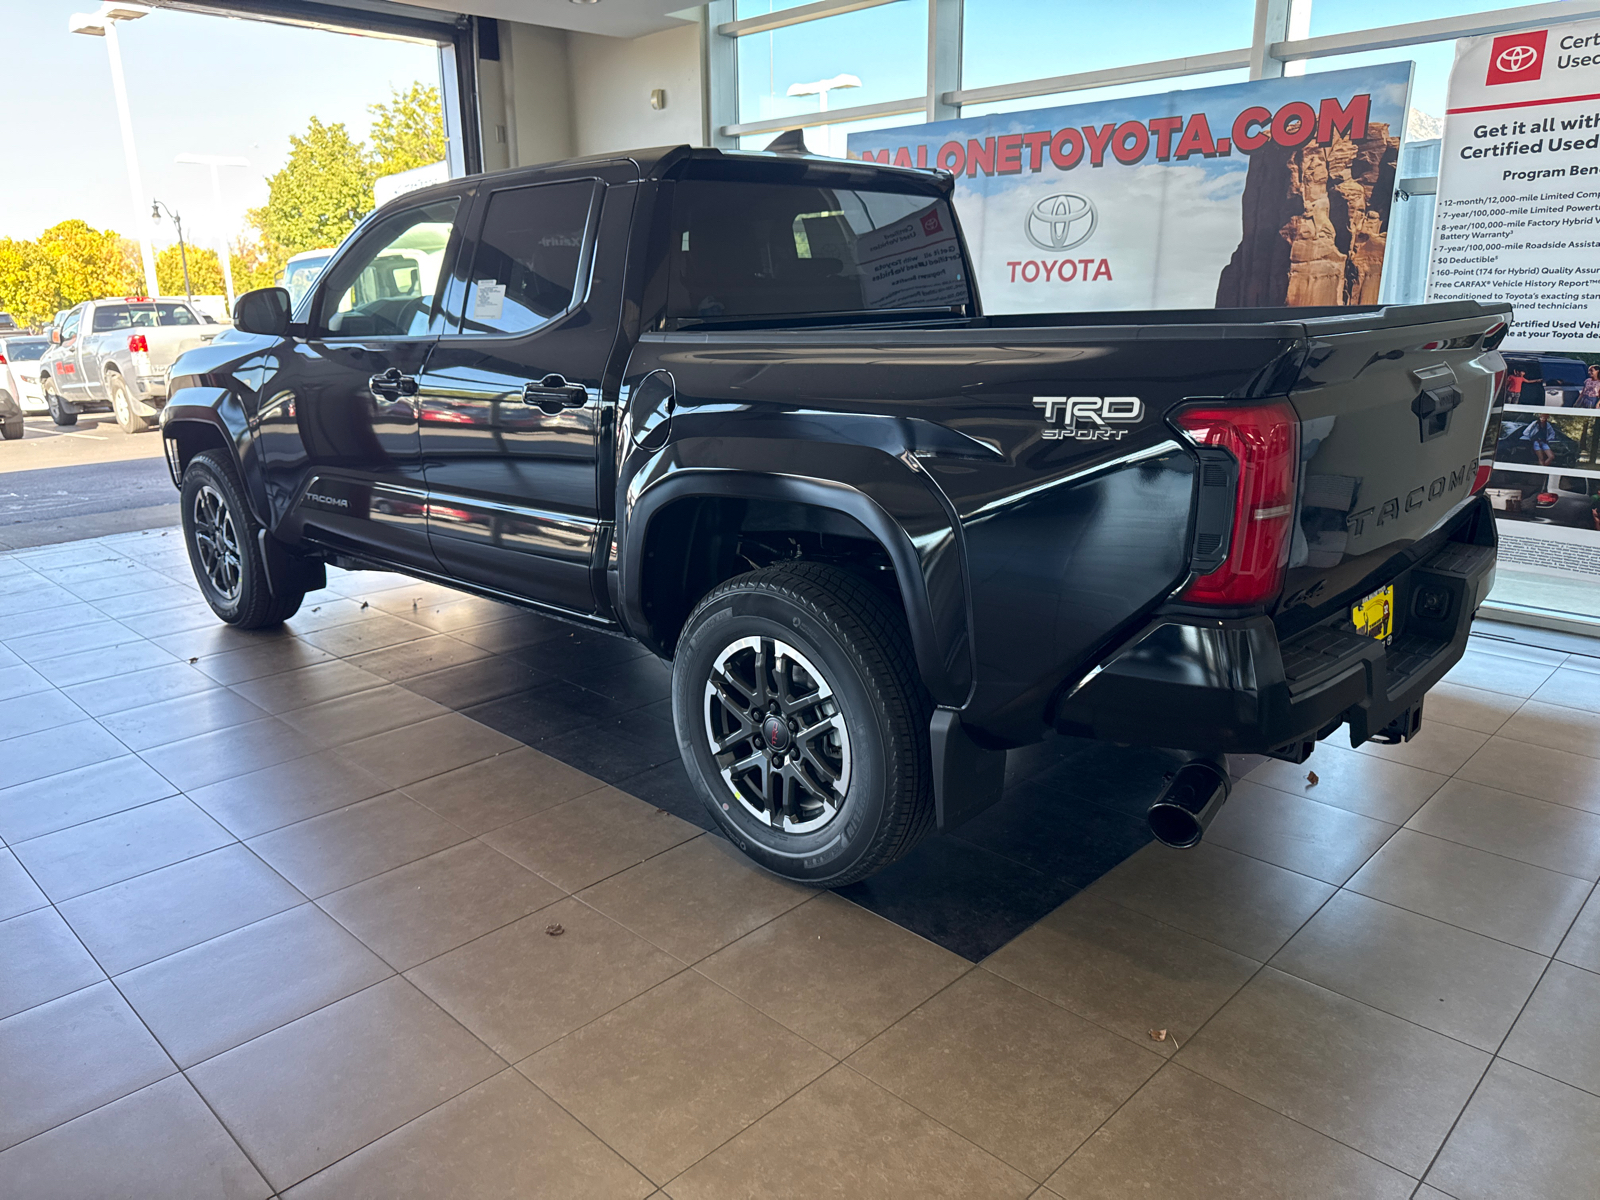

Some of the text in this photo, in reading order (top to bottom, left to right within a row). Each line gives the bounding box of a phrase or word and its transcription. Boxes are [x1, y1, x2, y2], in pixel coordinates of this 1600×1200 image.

[1473, 113, 1600, 139] Get it all with
[862, 94, 1371, 179] MALONETOYOTA.COM
[1460, 134, 1600, 160] Certified Used
[1502, 164, 1600, 182] Program Ben
[1444, 193, 1539, 207] 12-month/12,000-mile
[1540, 191, 1575, 201] Limited
[1443, 203, 1600, 220] 7-year/100,000-mile Limited Powert
[1441, 220, 1526, 232] 8-year/100,000-mile
[1527, 219, 1561, 228] Factory
[1562, 216, 1594, 227] Hybrid
[1440, 233, 1470, 241] Battery
[1439, 241, 1524, 254] 7-year/100,000-mile
[1525, 241, 1567, 250] Roadside
[1437, 257, 1448, 265] $0
[1007, 259, 1113, 283] TOYOTA
[1436, 268, 1475, 276] 160-Point
[1475, 268, 1493, 276] (174
[1494, 267, 1506, 275] for
[1507, 267, 1540, 276] Hybrid)
[1541, 266, 1574, 276] Quality
[1492, 279, 1523, 288] Vehicle
[1524, 279, 1557, 289] History
[1433, 292, 1493, 300] Reconditioned
[1504, 292, 1539, 301] Toyota's
[1540, 292, 1579, 302] exacting
[1512, 302, 1588, 310] ained technicians
[1510, 320, 1551, 328] Certified
[1552, 320, 1577, 329] Used
[1516, 330, 1527, 338] at
[1527, 331, 1551, 340] your
[1551, 330, 1584, 340] Toyota
[1032, 396, 1145, 430] TRD
[1041, 428, 1128, 440] SPORT
[305, 492, 348, 508] TACOMA
[1346, 456, 1480, 540] TACOMA
